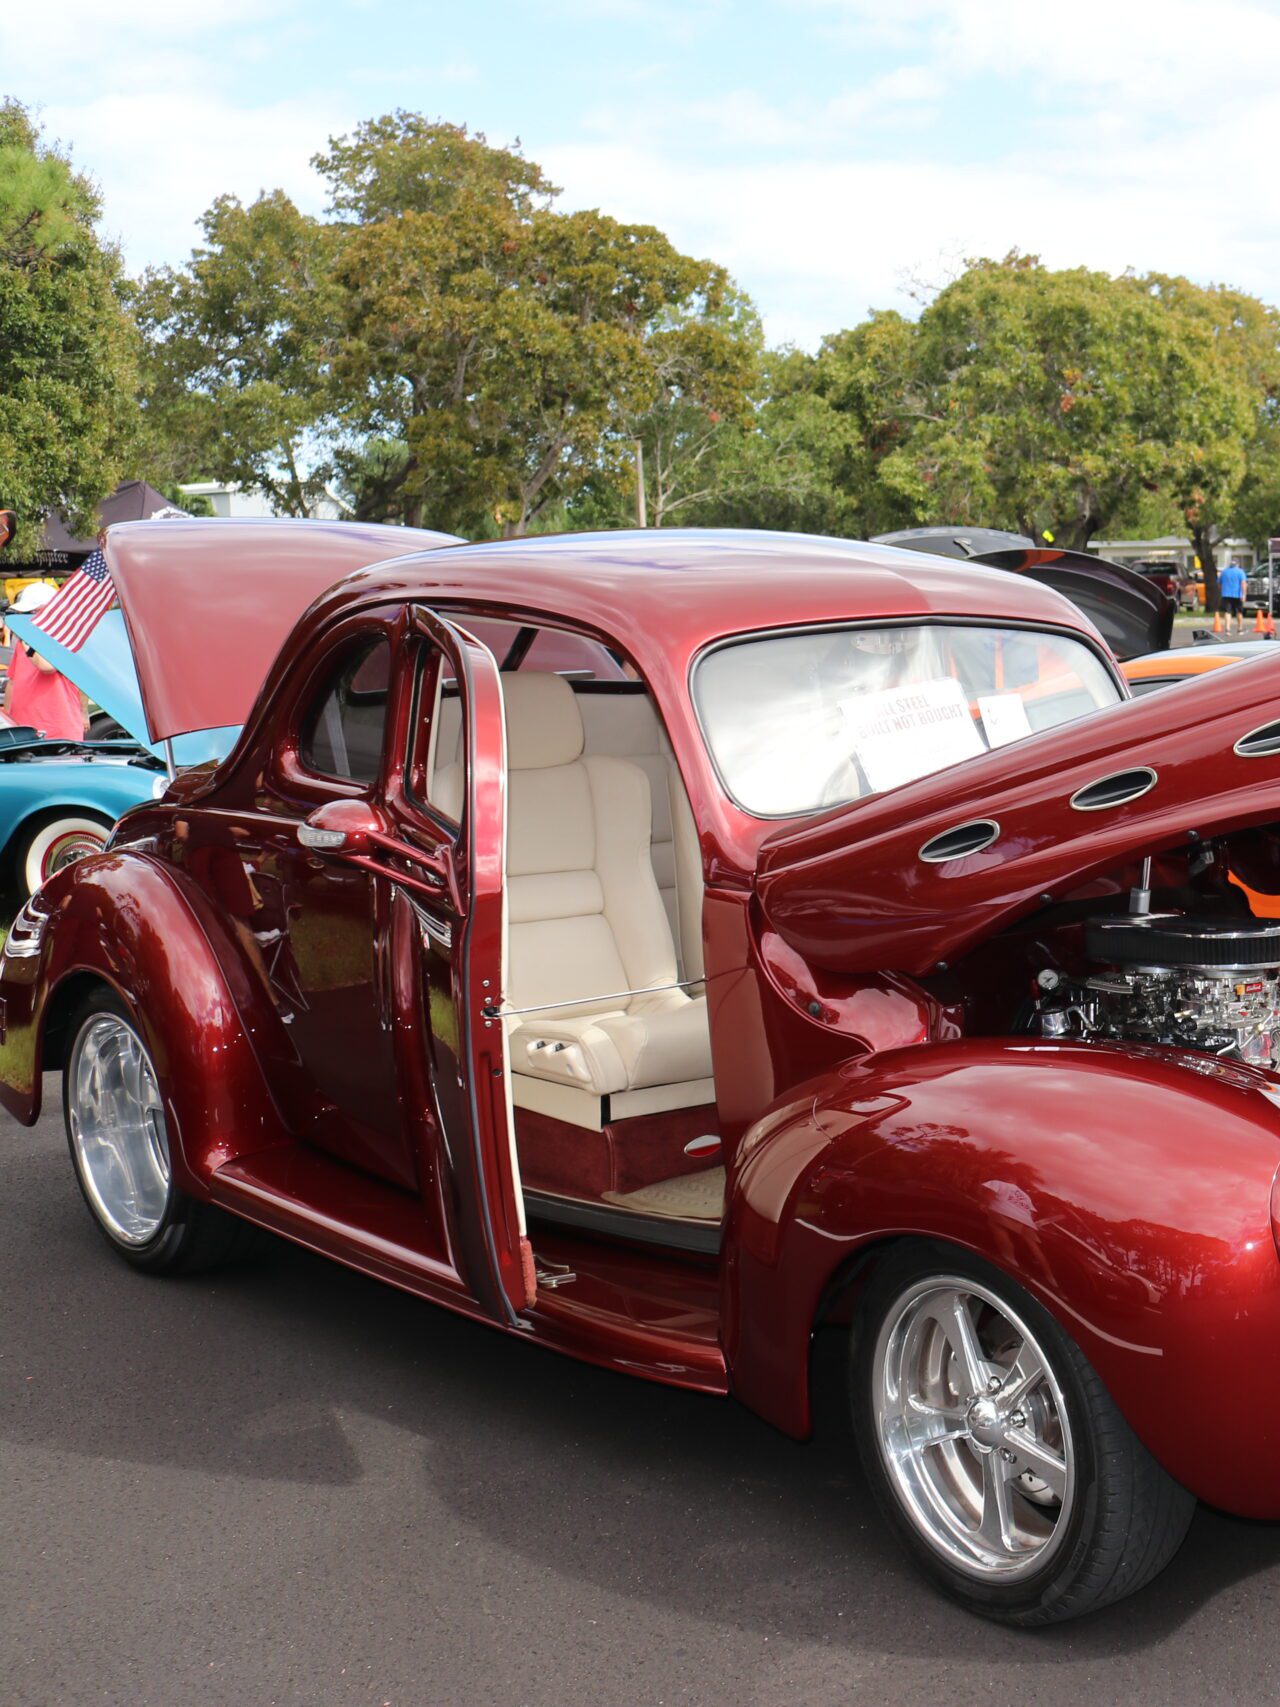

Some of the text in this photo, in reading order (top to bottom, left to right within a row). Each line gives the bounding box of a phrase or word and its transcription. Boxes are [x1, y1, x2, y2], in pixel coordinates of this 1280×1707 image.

[35, 549, 69, 568] hapter
[895, 694, 931, 714] STEEL
[893, 713, 918, 731] NOT
[917, 703, 964, 726] BOUGHT
